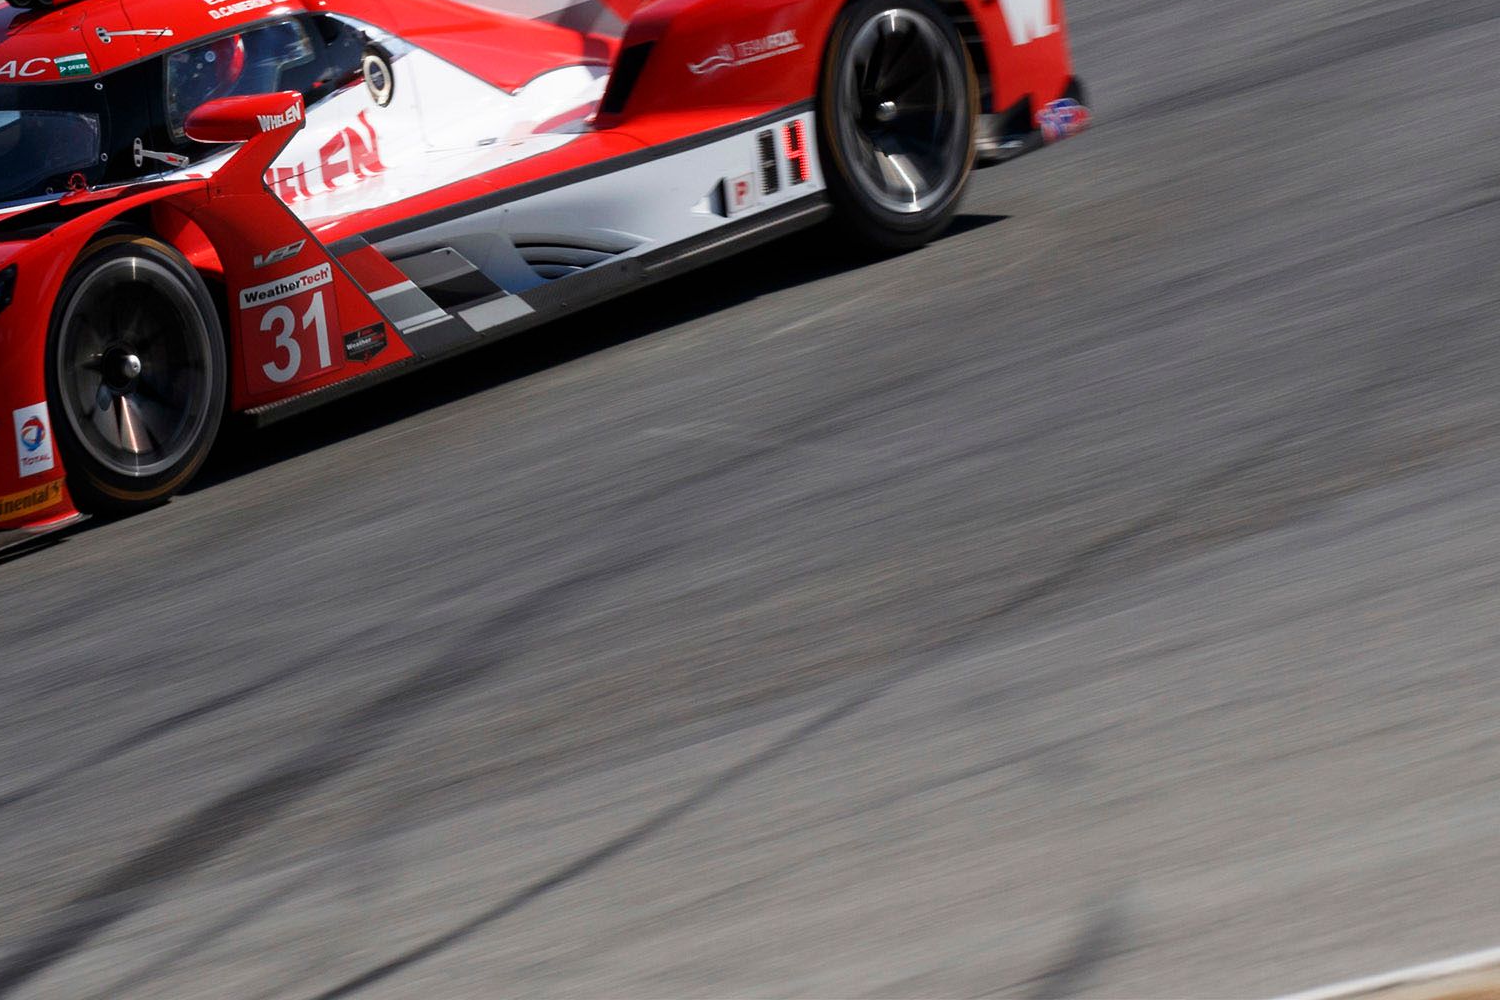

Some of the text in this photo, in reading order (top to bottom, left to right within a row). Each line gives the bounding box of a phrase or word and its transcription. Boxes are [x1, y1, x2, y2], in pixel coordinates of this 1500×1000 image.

[257, 99, 302, 133] WHELEN
[244, 267, 329, 304] WeatherTech
[260, 290, 332, 383] 31
[20, 454, 51, 467] TOTAL
